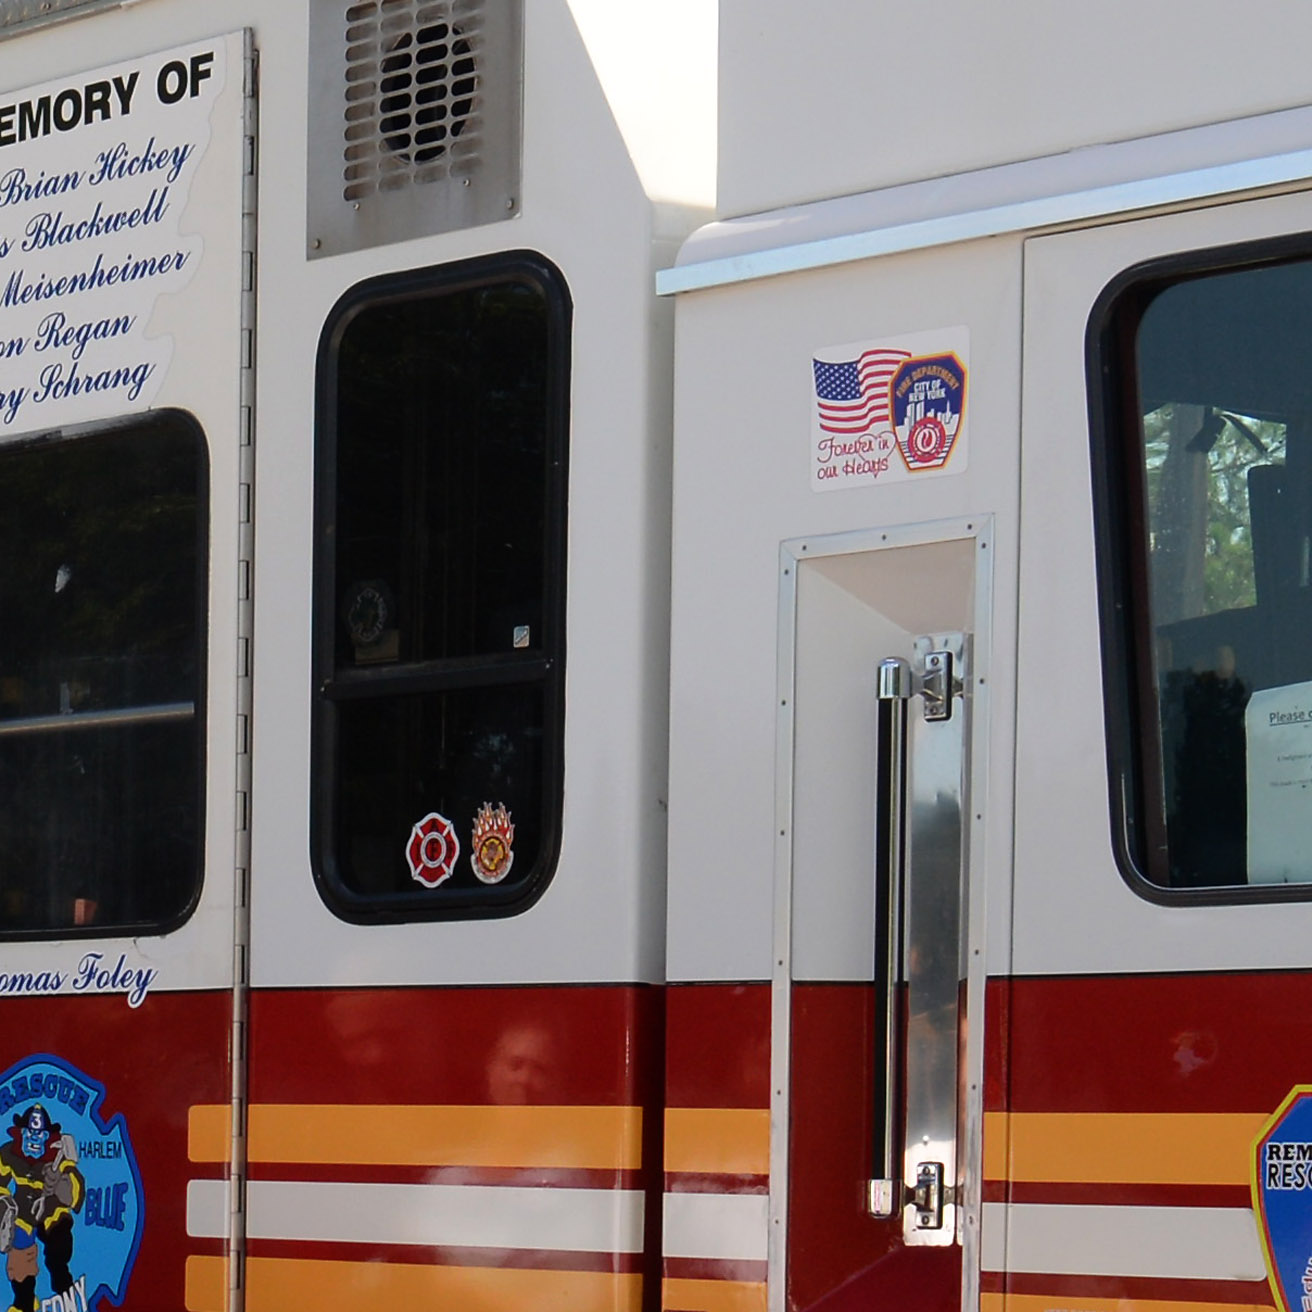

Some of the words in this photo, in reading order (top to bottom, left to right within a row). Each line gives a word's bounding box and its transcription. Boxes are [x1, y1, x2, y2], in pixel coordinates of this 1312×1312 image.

[156, 51, 215, 104] OF
[88, 135, 195, 187] Hickey
[21, 187, 170, 253] Blackwell
[33, 311, 136, 362] Regan
[32, 360, 157, 404] Schrang
[817, 436, 874, 464] Forever
[817, 464, 839, 480] our
[1270, 711, 1305, 723] Please
[73, 953, 159, 1006] Foley
[30, 1111, 42, 1129] 3
[78, 1140, 123, 1160] HARLEM
[85, 1181, 130, 1232] BLUE
